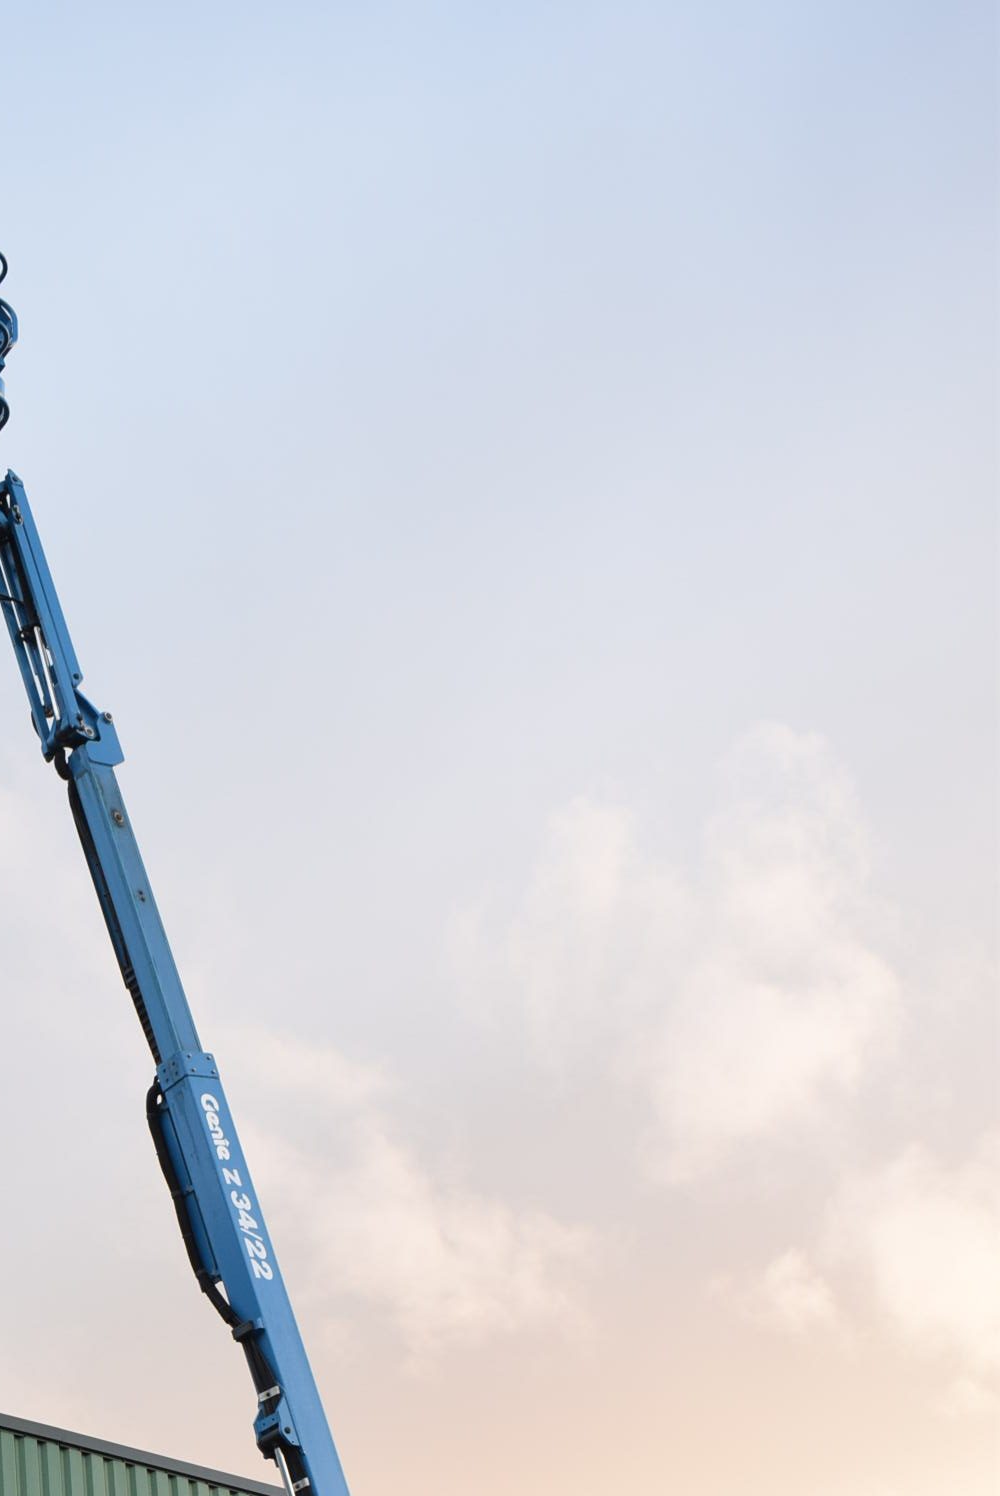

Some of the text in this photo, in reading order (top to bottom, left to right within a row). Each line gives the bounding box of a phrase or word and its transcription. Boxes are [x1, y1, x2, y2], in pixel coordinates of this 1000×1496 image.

[200, 1093, 274, 1281] Genie Z 34/22
